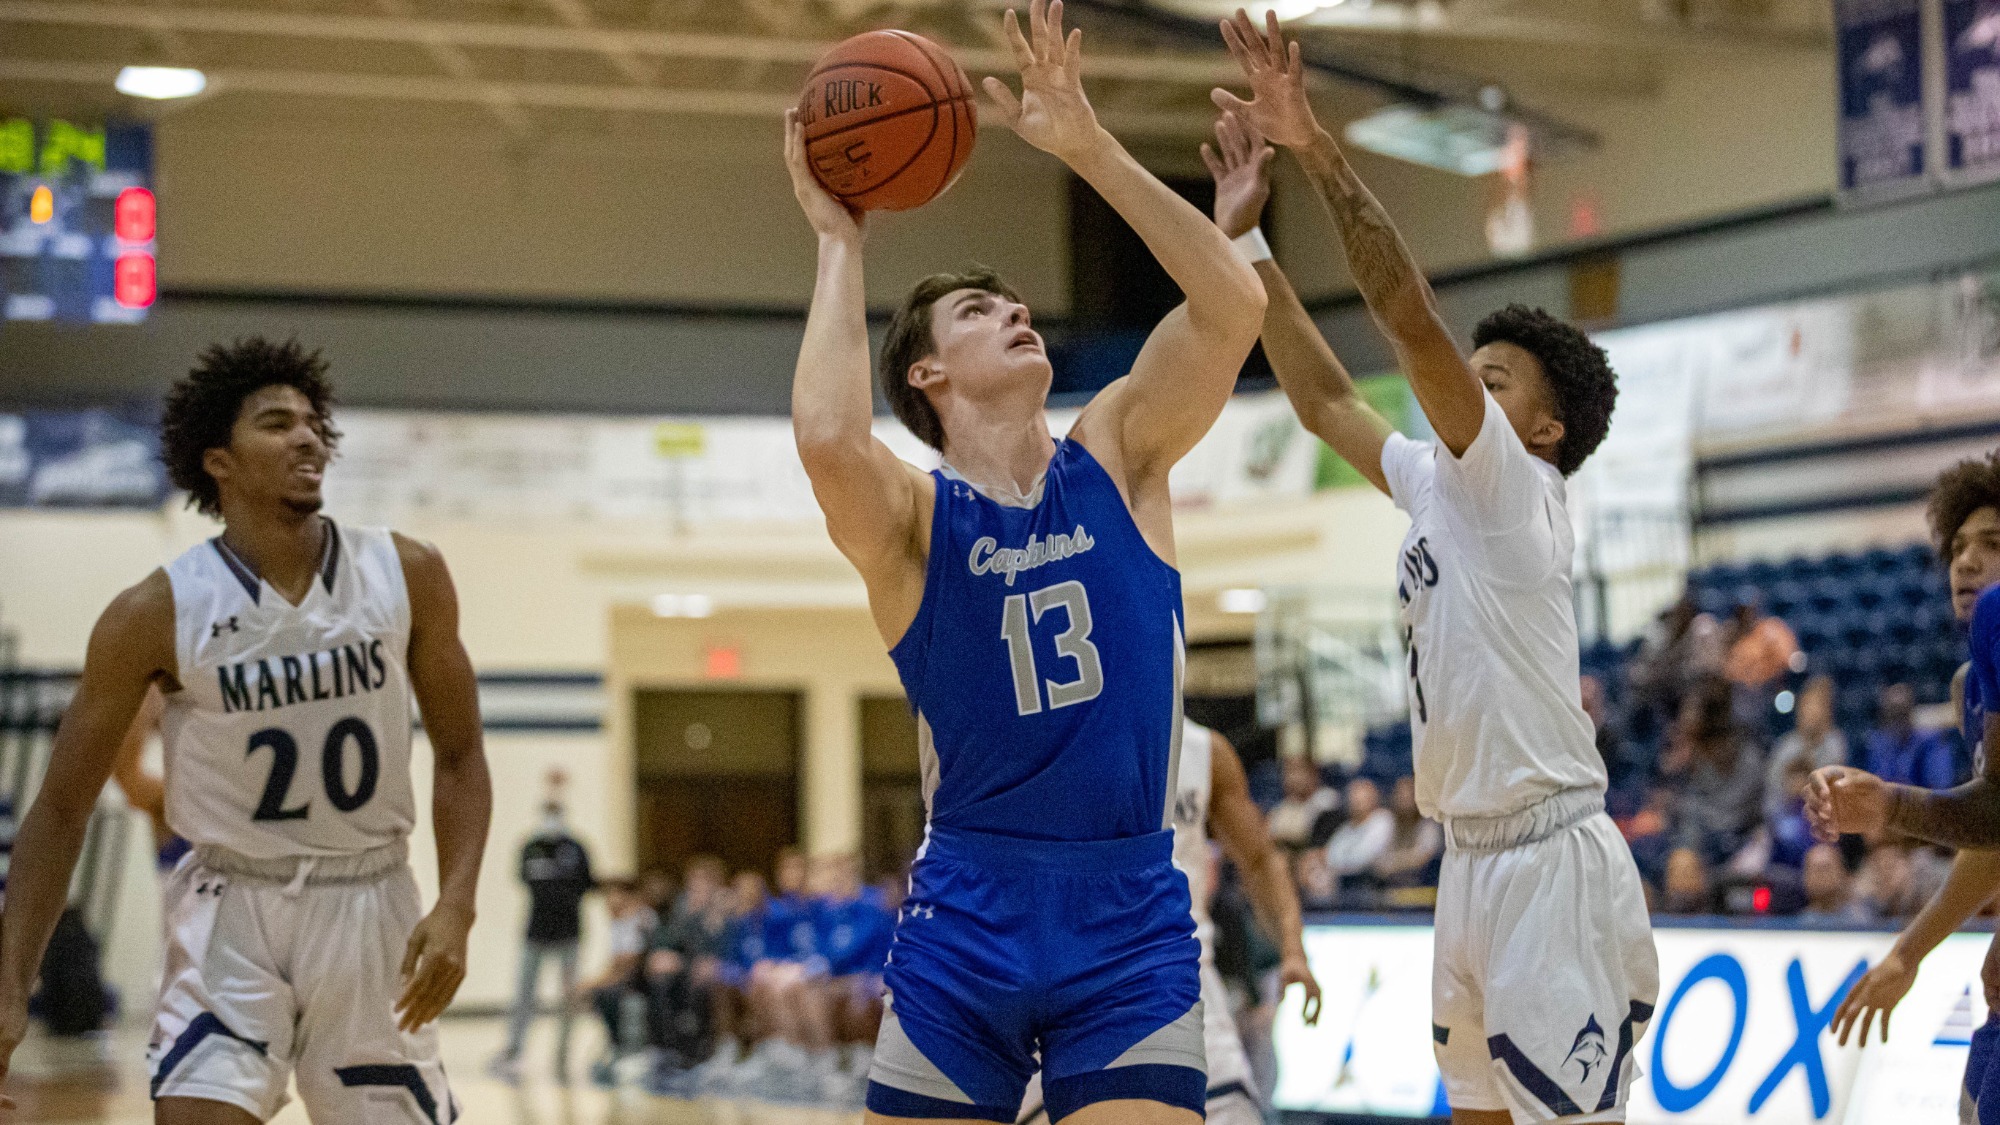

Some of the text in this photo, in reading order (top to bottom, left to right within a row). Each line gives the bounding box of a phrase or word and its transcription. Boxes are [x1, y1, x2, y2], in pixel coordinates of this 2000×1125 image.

[824, 80, 883, 118] ROCK
[218, 639, 386, 713] MARLINS
[1001, 580, 1104, 716] 13
[245, 716, 380, 821] 20
